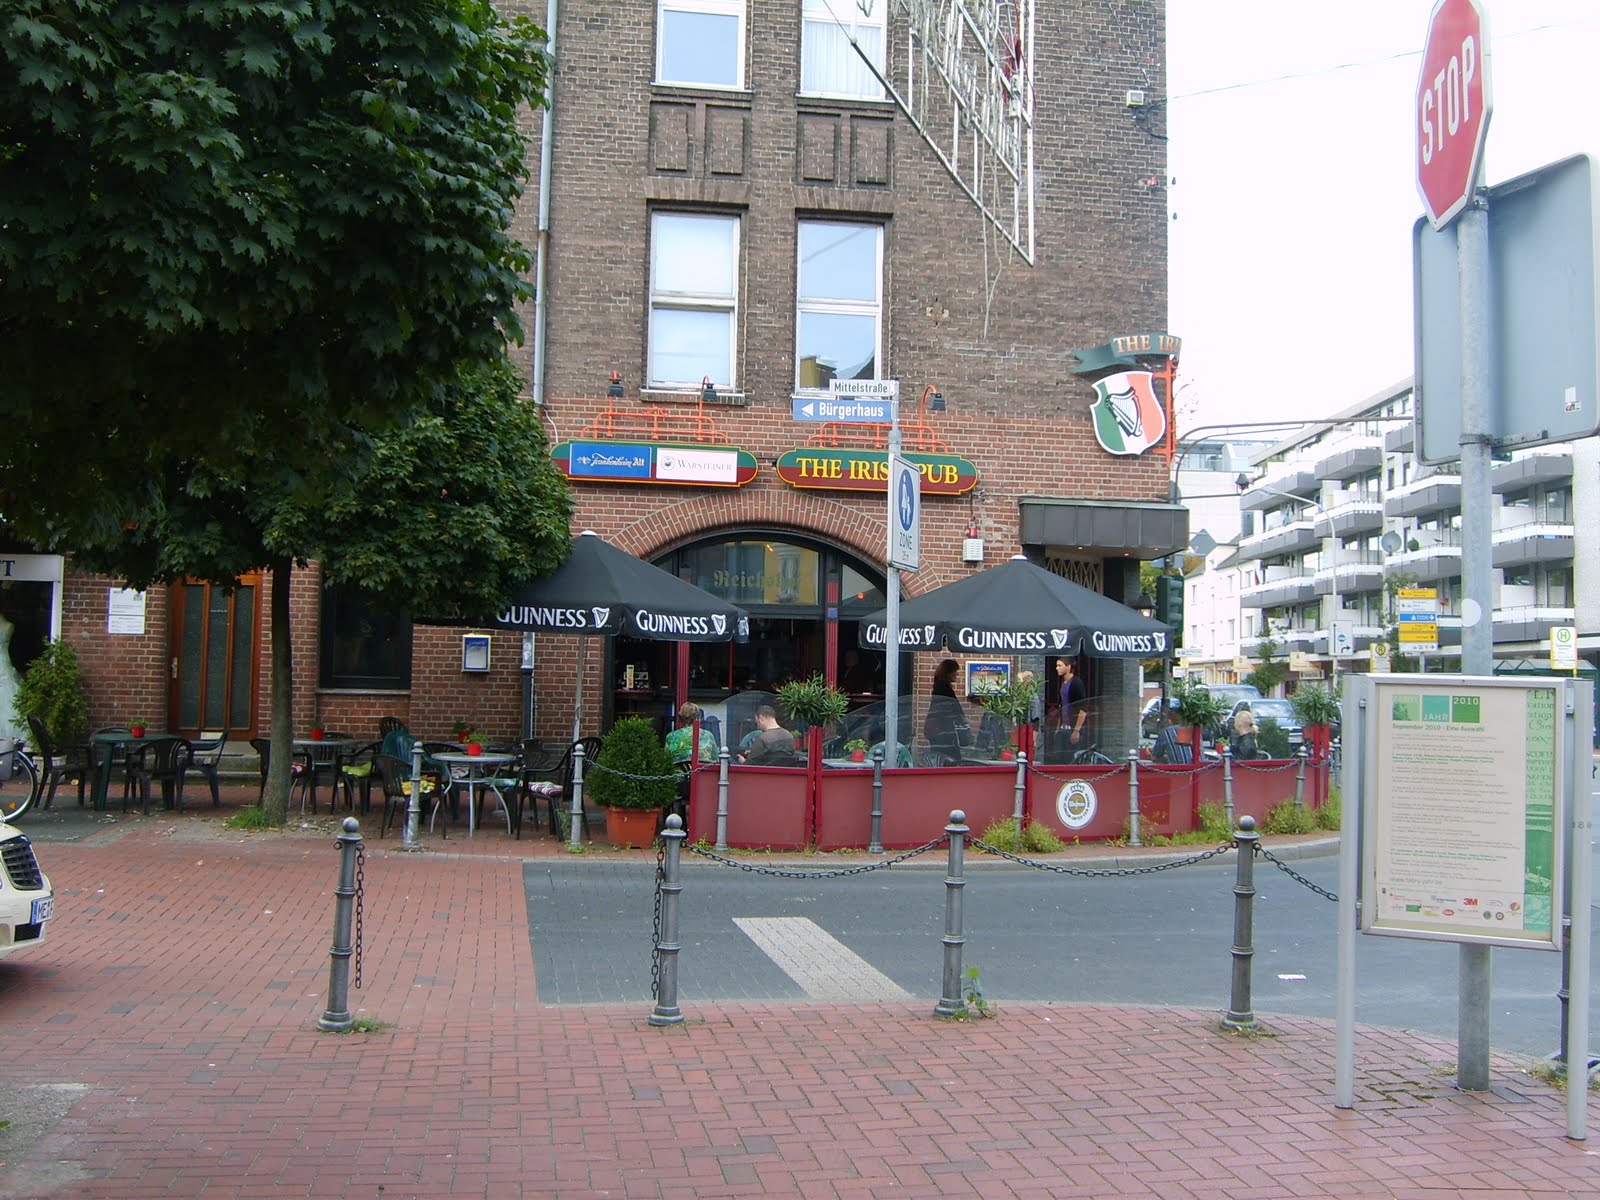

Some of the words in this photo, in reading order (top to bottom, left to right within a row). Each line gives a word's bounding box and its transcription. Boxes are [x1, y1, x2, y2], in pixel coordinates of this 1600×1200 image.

[1422, 35, 1475, 165] STOP
[1112, 334, 1152, 353] THE
[833, 382, 888, 394] Mittelstraße
[819, 402, 884, 419] Bürgerhaus
[677, 459, 732, 471] WARSTEINER
[796, 458, 843, 479] THE
[848, 460, 890, 481] IRIS
[899, 532, 912, 550] ZONE
[635, 609, 708, 635] GUINNESS
[958, 627, 1046, 649] GUINNESS
[1093, 630, 1152, 652] GUINNESS
[1453, 697, 1479, 705] 2010
[1423, 713, 1449, 721] JAHR
[1463, 898, 1478, 906] 3M
